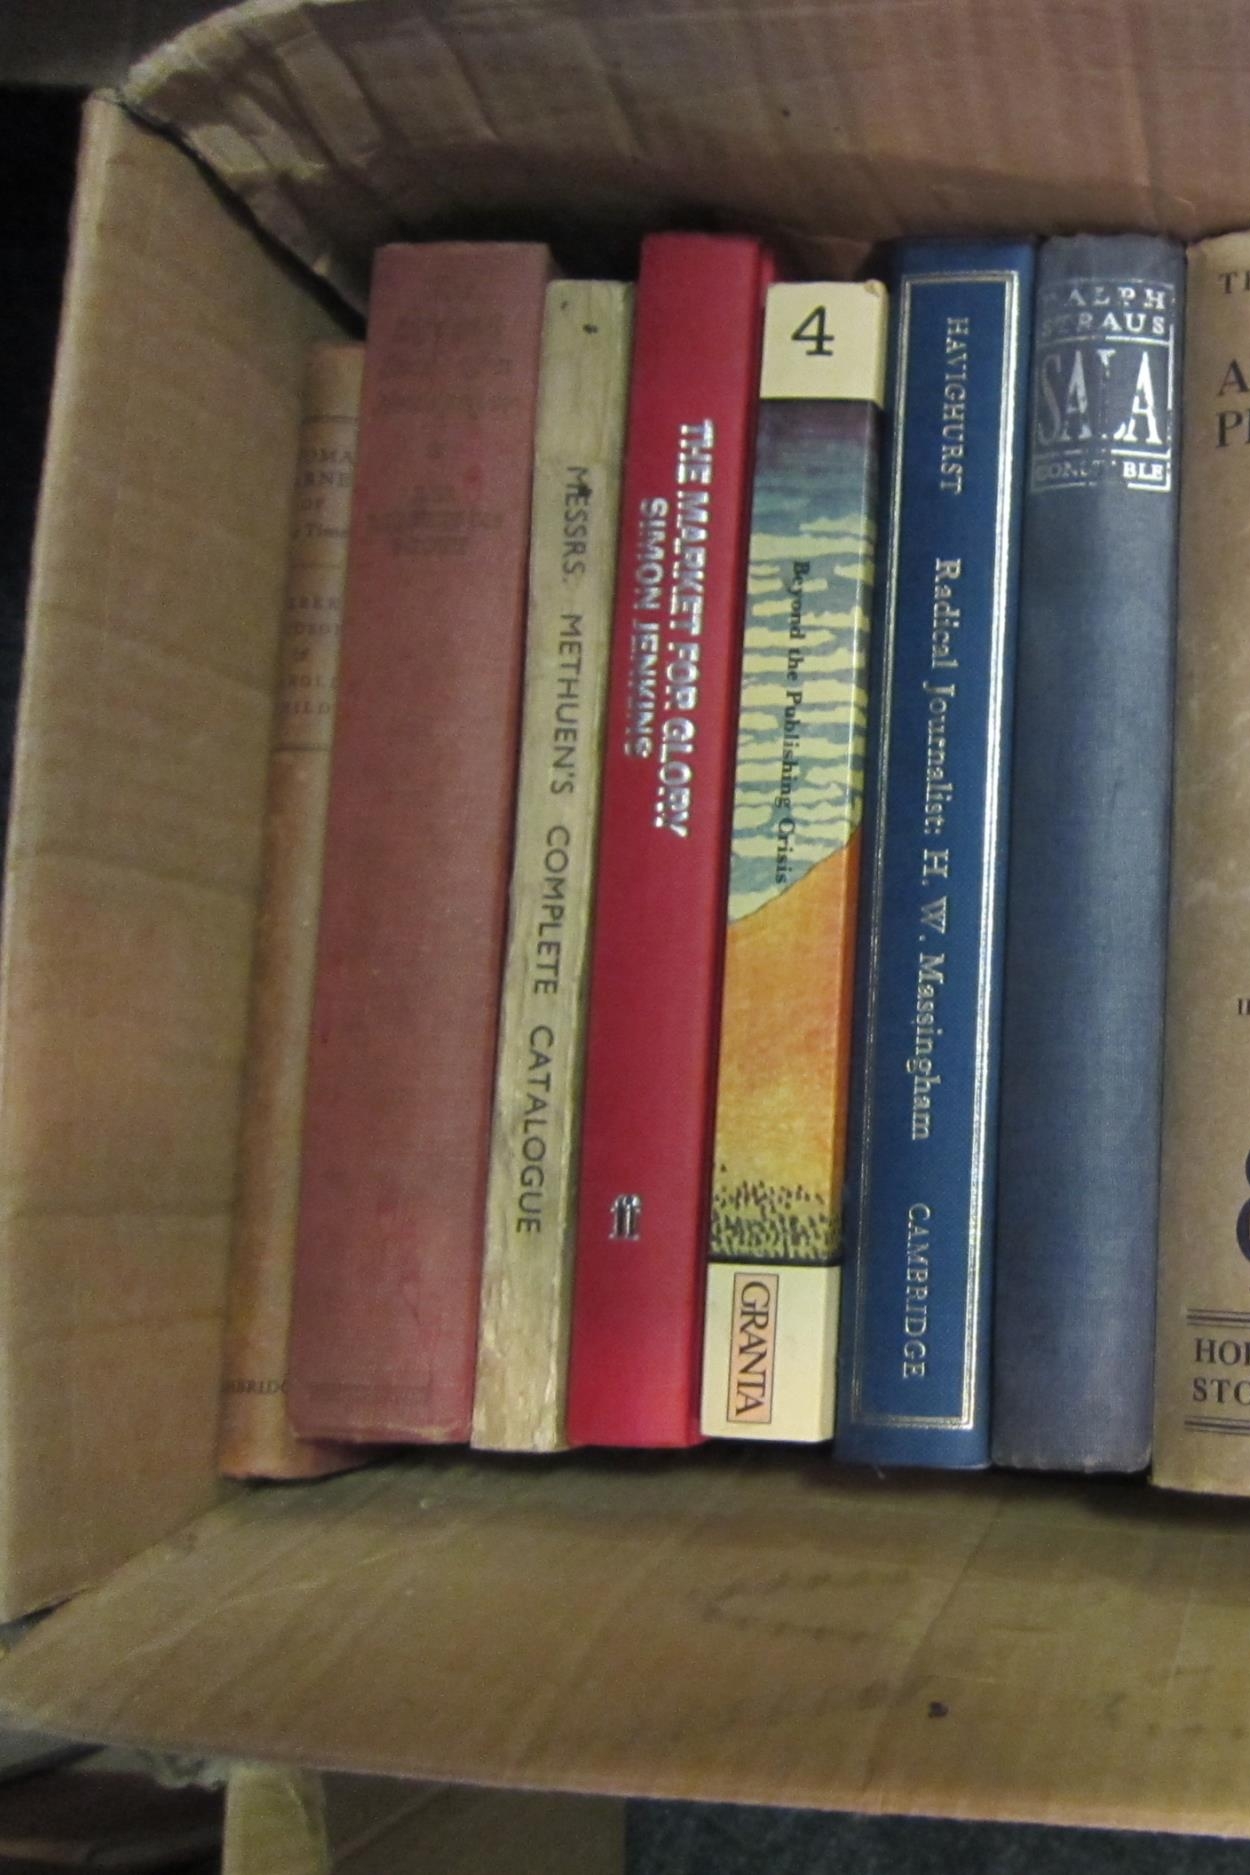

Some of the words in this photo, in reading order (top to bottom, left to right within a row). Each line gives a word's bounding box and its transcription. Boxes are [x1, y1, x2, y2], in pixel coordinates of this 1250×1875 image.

[792, 305, 834, 356] 4
[678, 419, 714, 484] THE
[939, 316, 969, 495] HAVIGHURST
[562, 465, 592, 584] MESSRS.
[633, 497, 667, 610] SIMON
[669, 490, 711, 636] MARKET
[788, 561, 810, 639] Beyond
[932, 559, 961, 669] Radical
[551, 614, 584, 795] METHUEN'S
[624, 620, 660, 758] JENKINS
[665, 641, 699, 710] FOR
[787, 642, 804, 681] the
[654, 717, 695, 838] GLORY
[776, 690, 803, 810] Publishing
[923, 681, 956, 834] Journalist:
[774, 814, 797, 884] Crisis
[923, 850, 950, 886] H.
[536, 825, 572, 994] COMPLETE
[917, 896, 948, 941] W.
[906, 953, 944, 1141] Massingham
[515, 1025, 555, 1235] CATALOGUE
[735, 1280, 772, 1416] GRANTA
[902, 1204, 930, 1379] CAMBRIDGE
